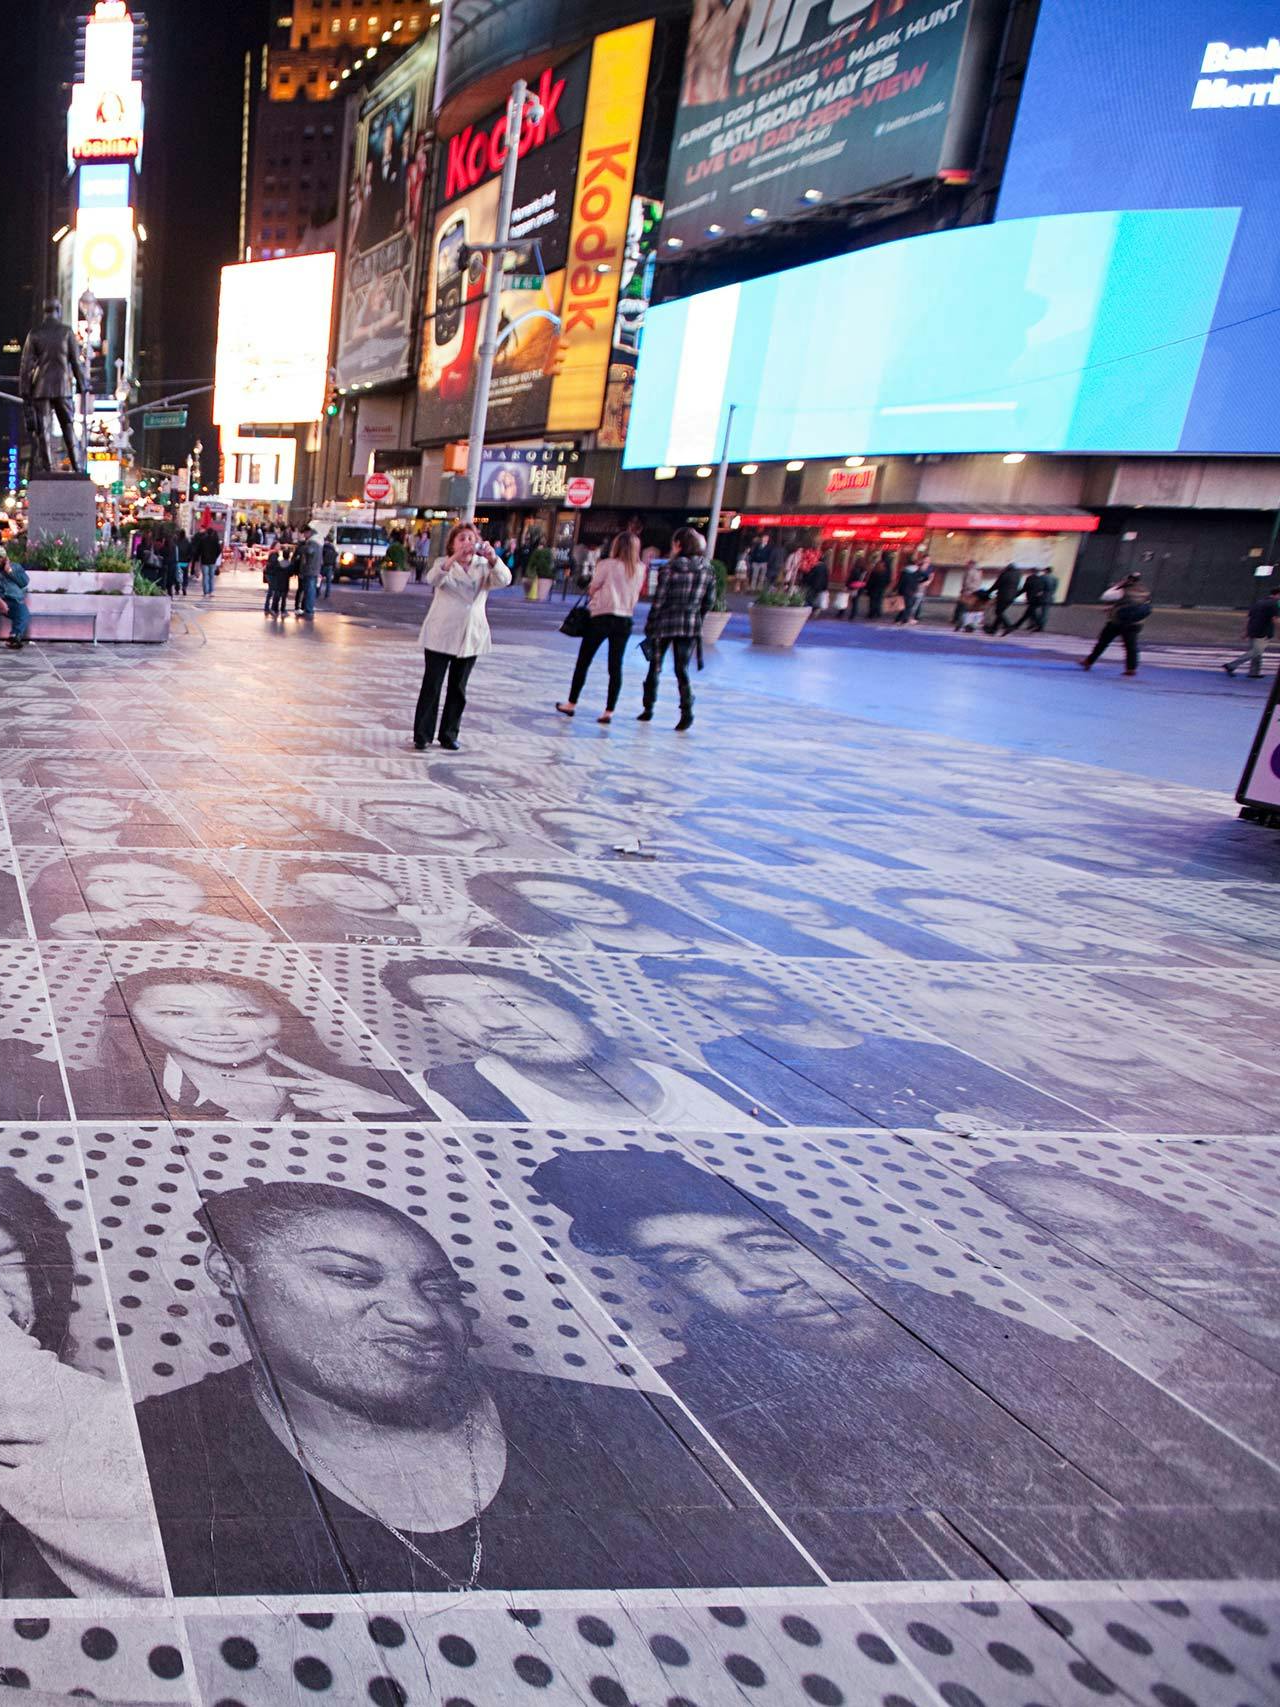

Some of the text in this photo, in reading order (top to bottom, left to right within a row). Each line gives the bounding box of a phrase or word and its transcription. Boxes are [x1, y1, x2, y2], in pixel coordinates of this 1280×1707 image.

[709, 91, 814, 156] SATURDAY
[811, 69, 864, 111] MAY
[862, 52, 900, 88] 25
[723, 100, 756, 127] DOS
[755, 68, 820, 112] SANTOS
[846, 27, 903, 70] MARK
[904, 0, 964, 41] HUNT
[73, 137, 138, 160] TOSHIBA
[686, 152, 726, 186] LIVE
[730, 138, 758, 166] ON
[761, 62, 928, 150] PAY-PER-VIEW
[562, 140, 632, 334] Kodak
[482, 450, 580, 464] MARQUIS
